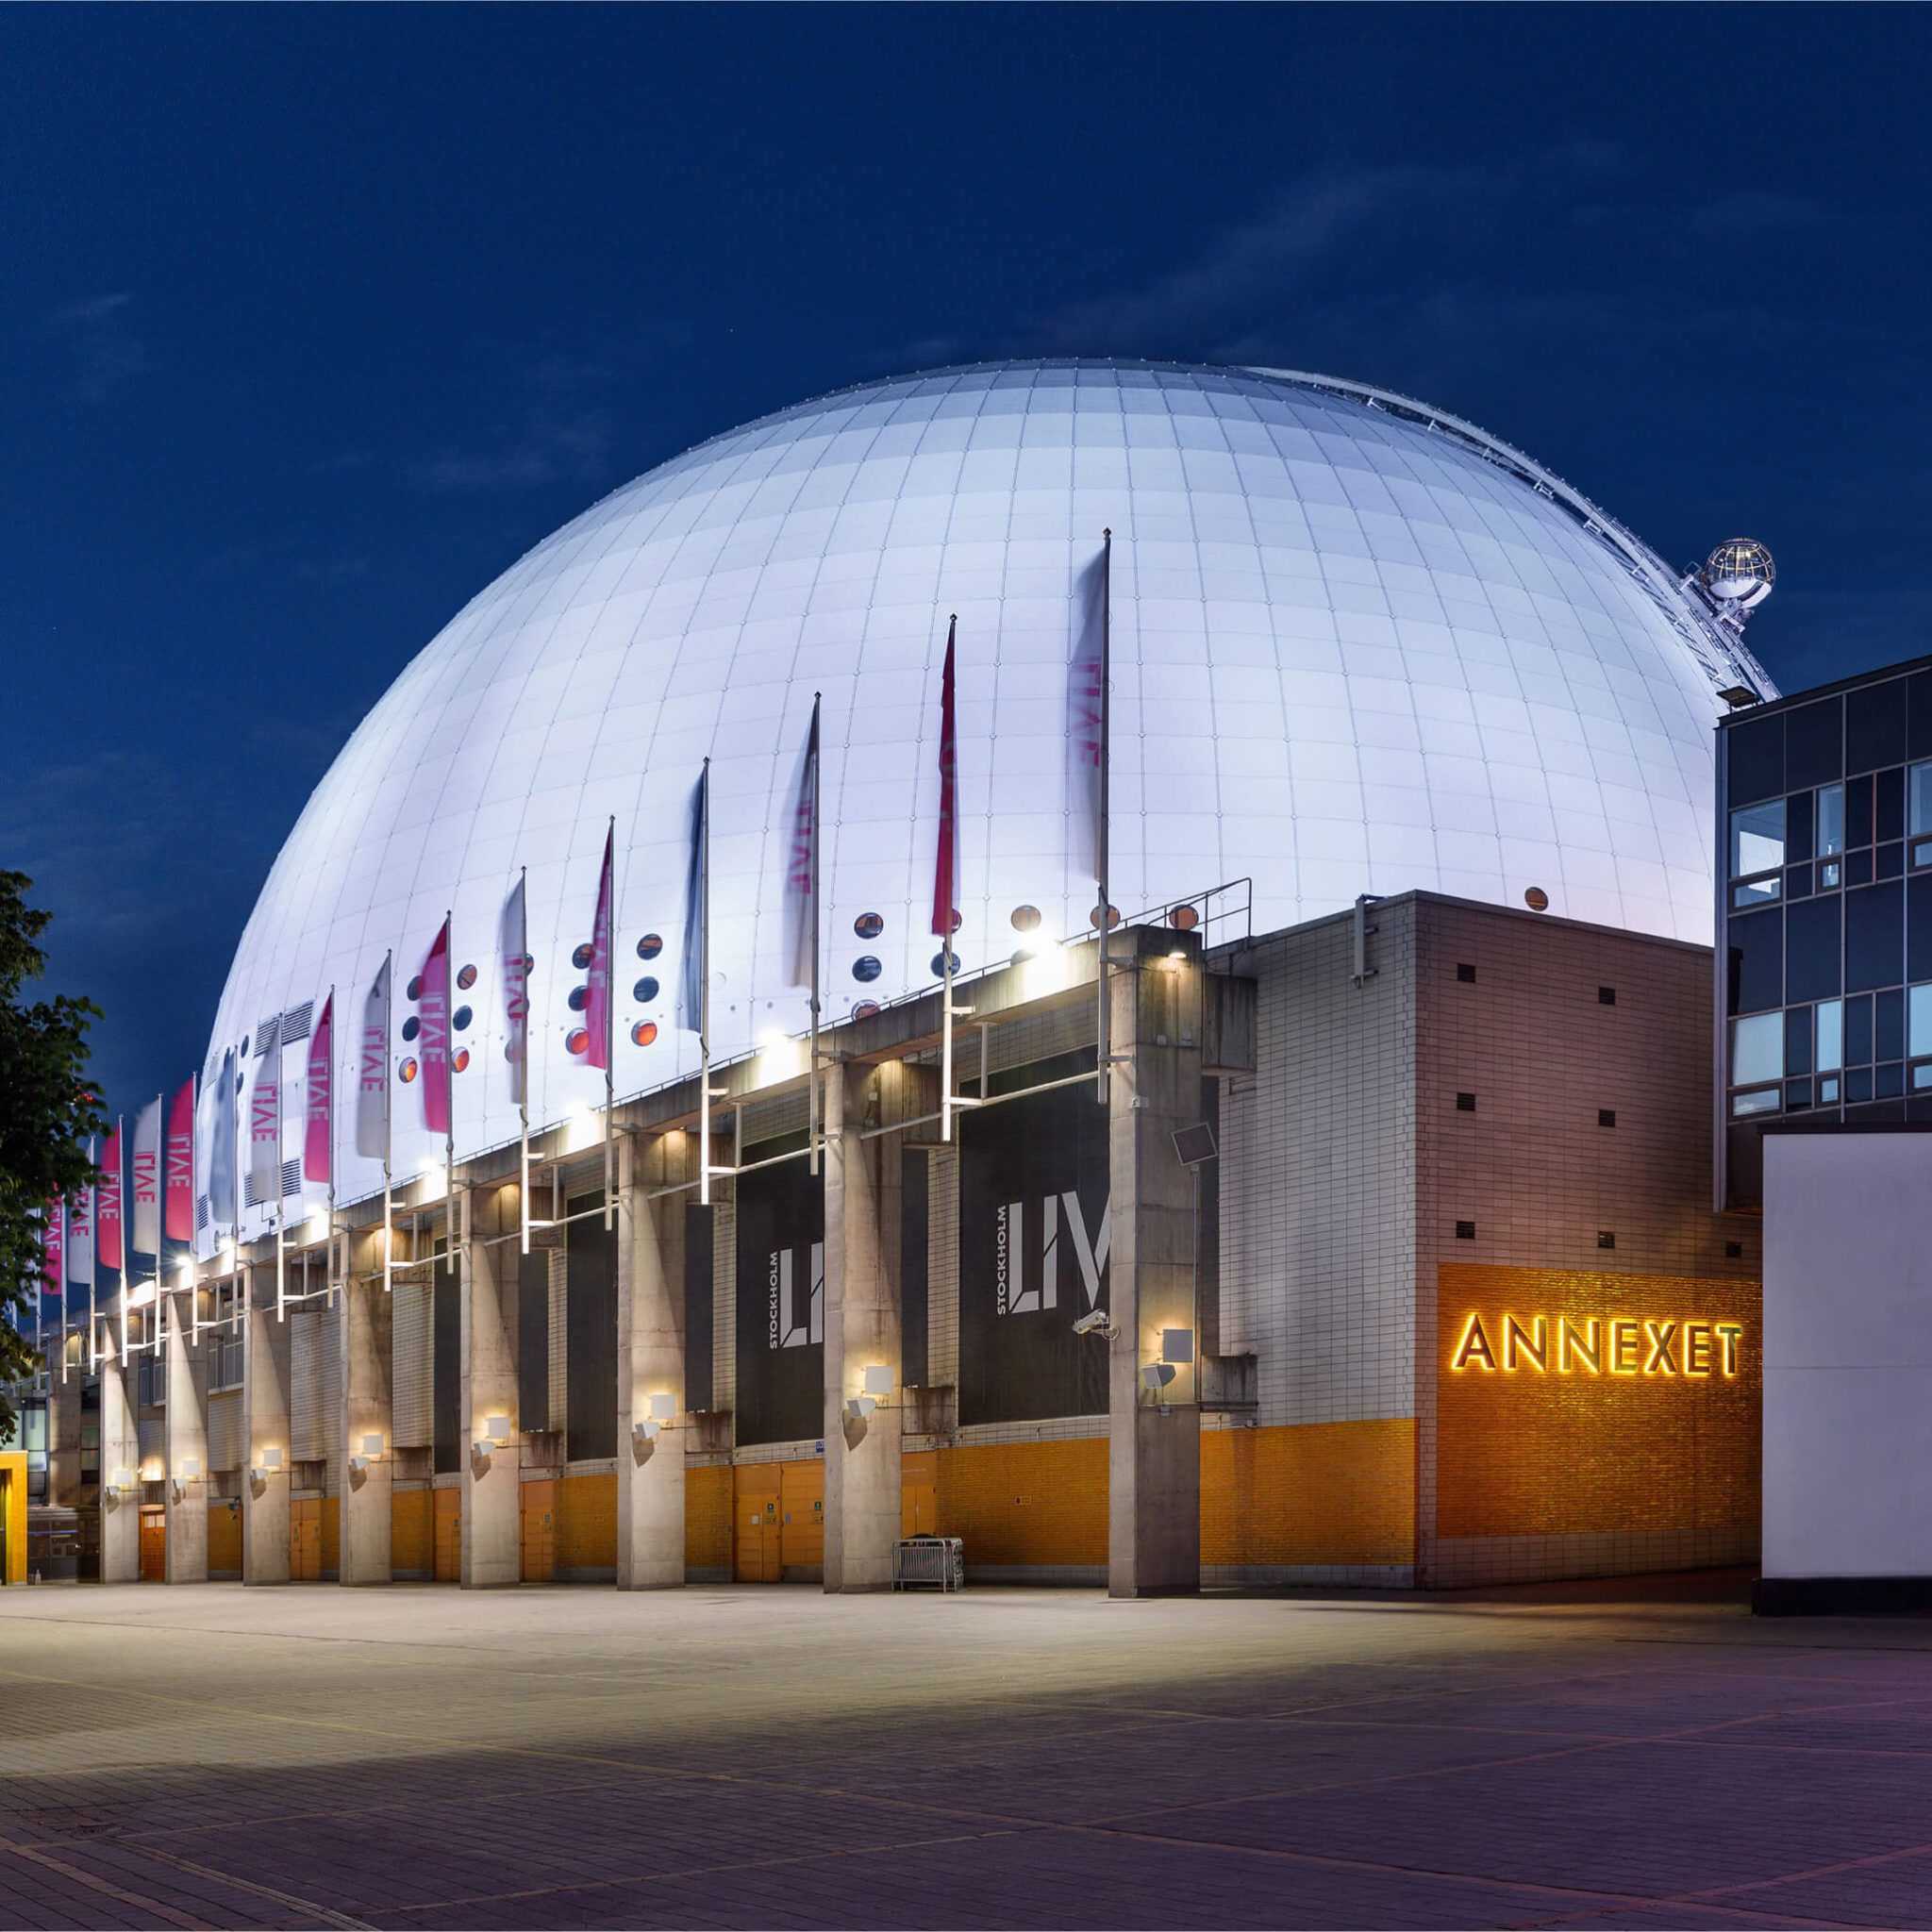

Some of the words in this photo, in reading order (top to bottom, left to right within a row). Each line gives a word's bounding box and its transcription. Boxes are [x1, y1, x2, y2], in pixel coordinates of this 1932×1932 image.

[769, 1251, 778, 1350] STOCKHOLM
[779, 1241, 824, 1348] LI
[997, 1206, 1007, 1315] STOCKHOLM
[1008, 1191, 1110, 1314] LIV
[1452, 1312, 1743, 1376] ANNEXET
